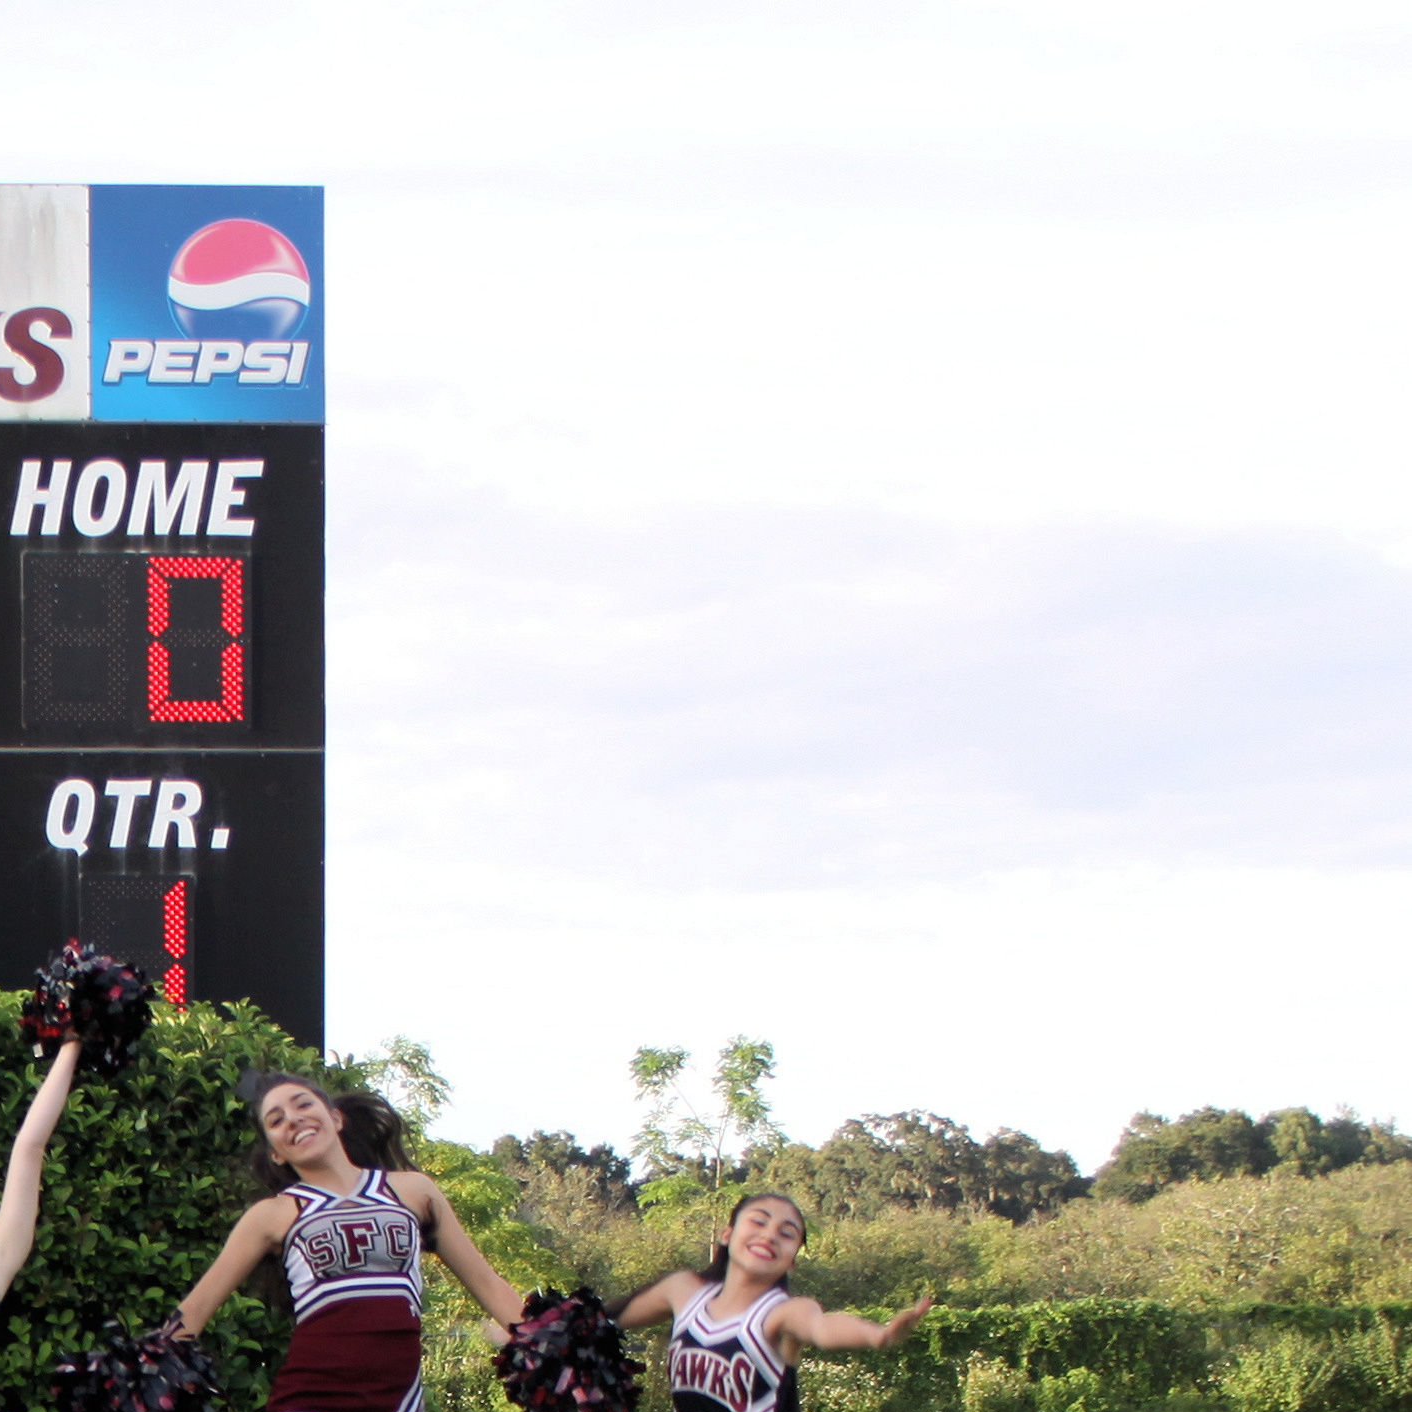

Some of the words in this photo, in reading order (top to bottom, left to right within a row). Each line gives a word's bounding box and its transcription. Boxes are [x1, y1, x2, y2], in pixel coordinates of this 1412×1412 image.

[103, 340, 309, 384] PEPSI
[10, 459, 265, 537] HOME
[148, 556, 244, 722] 0
[45, 779, 230, 856] QTR.
[306, 1217, 413, 1273] SFC
